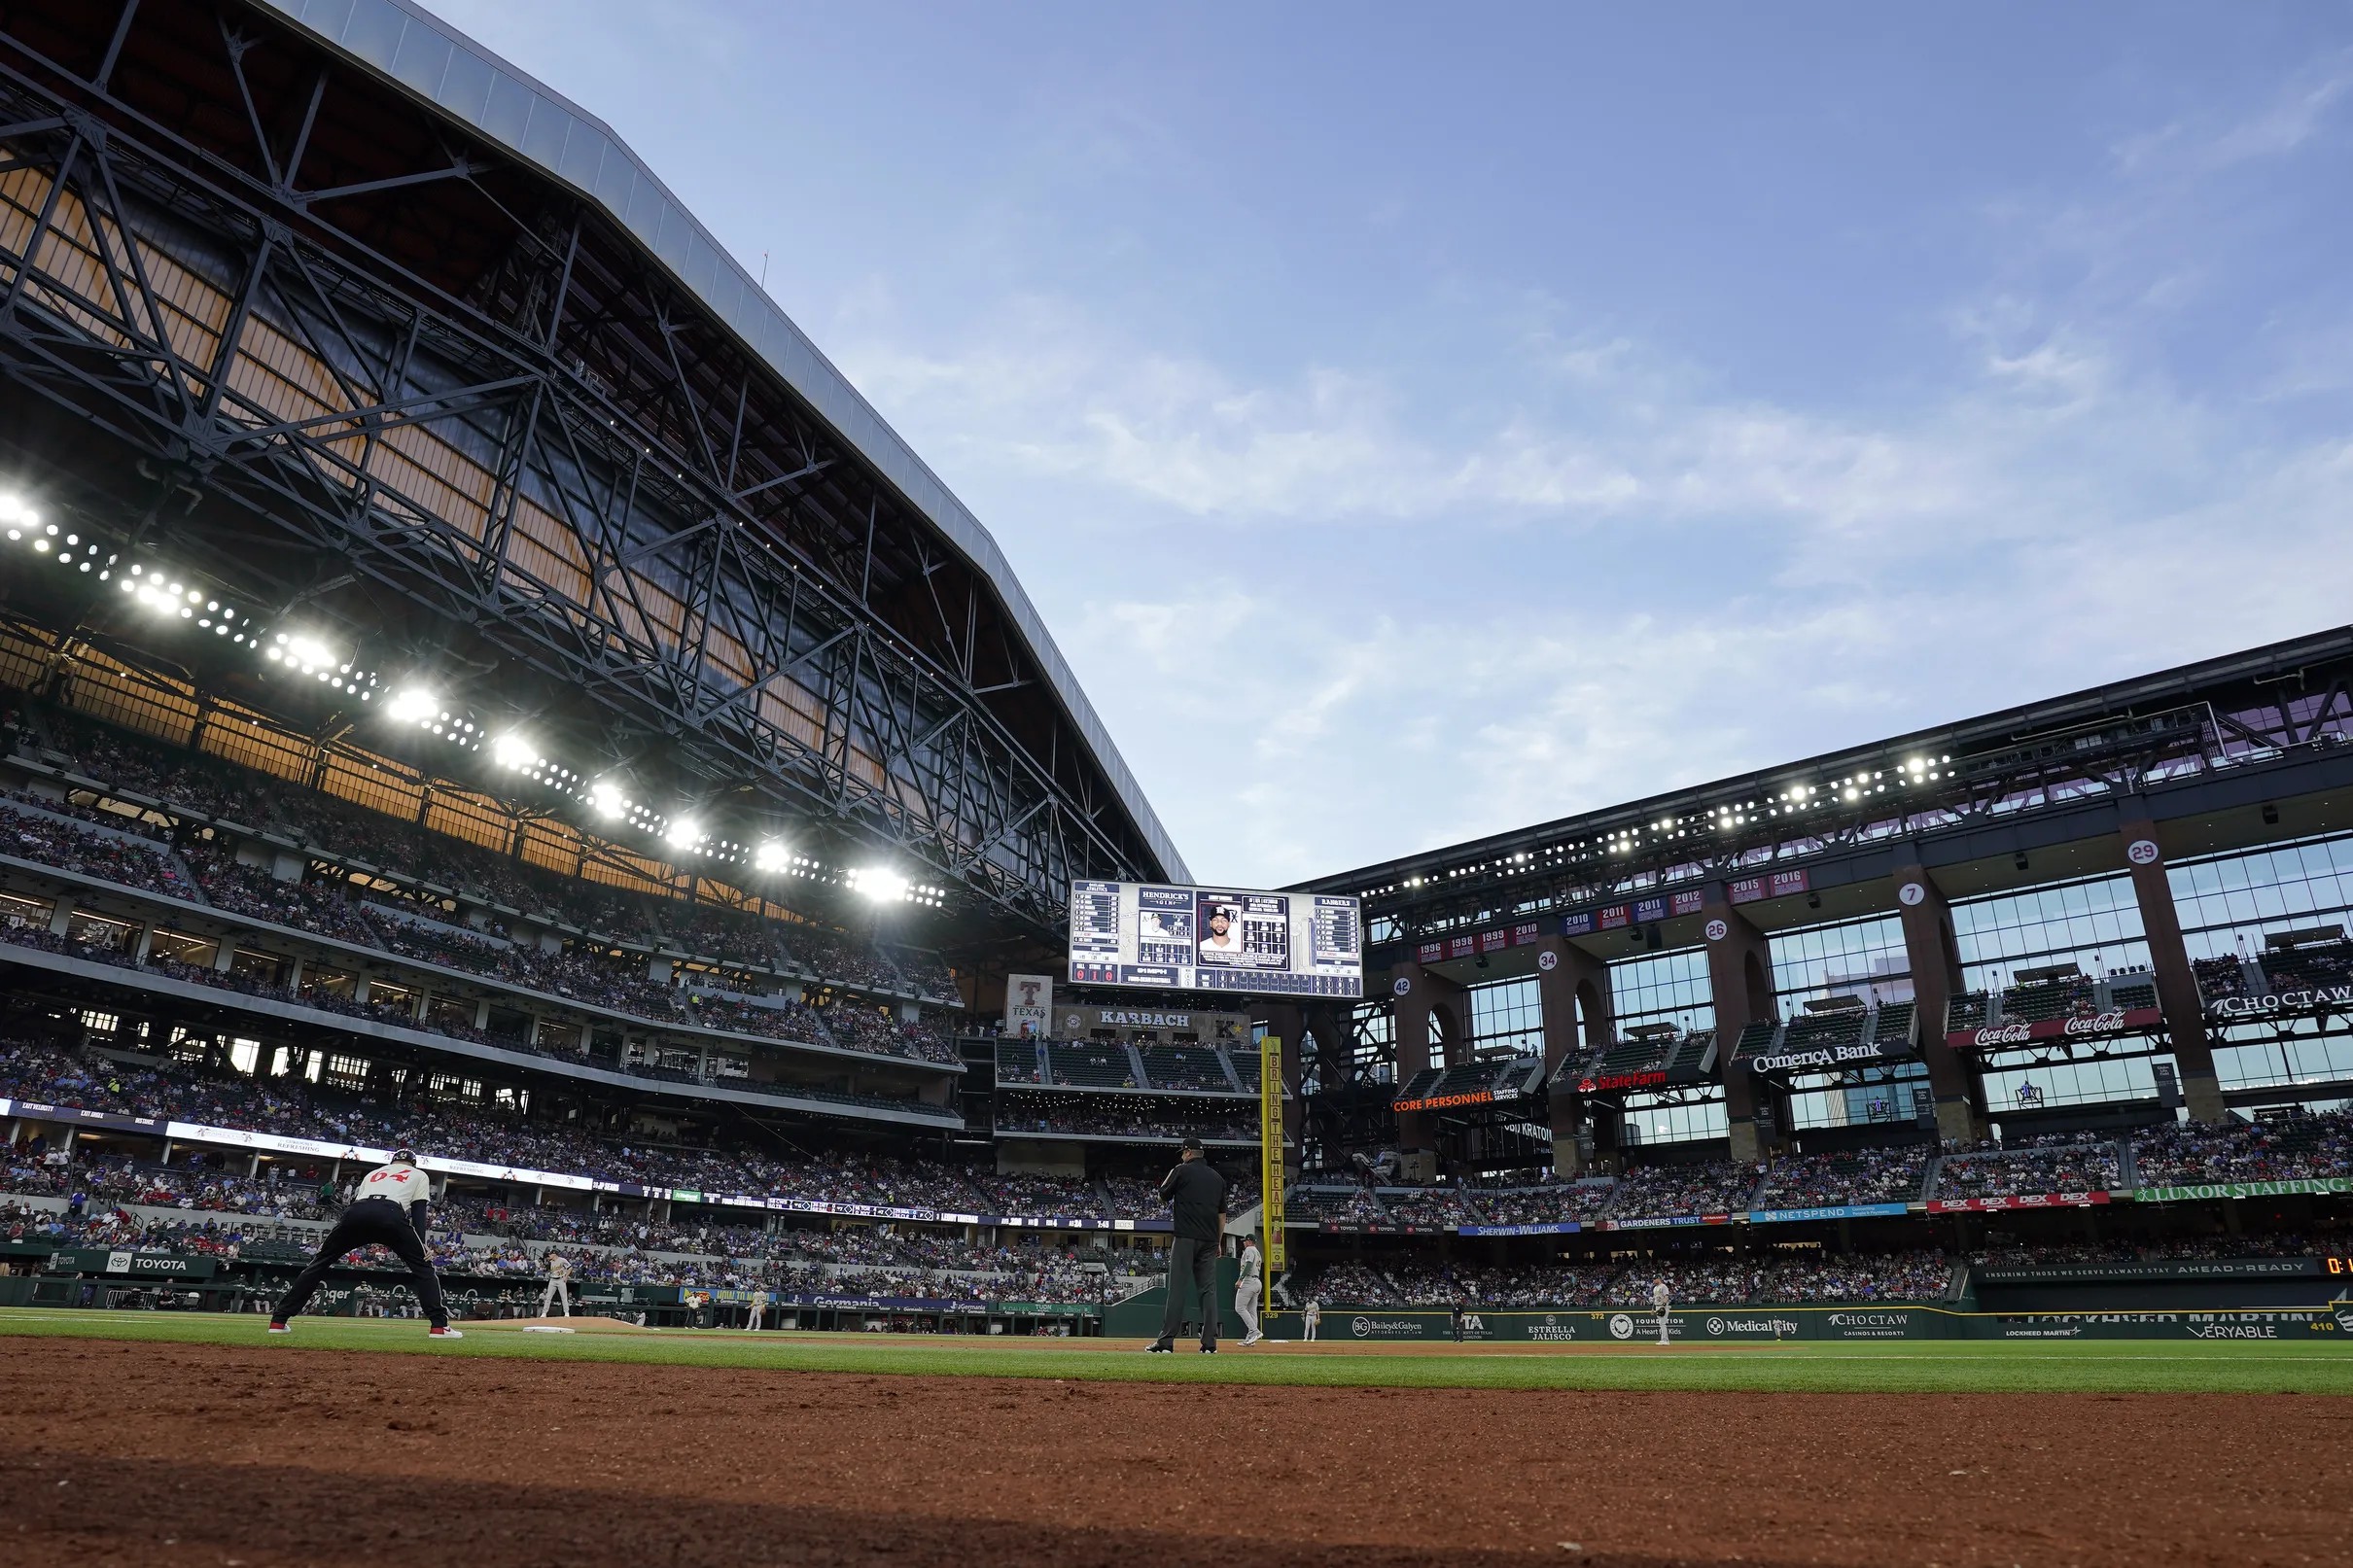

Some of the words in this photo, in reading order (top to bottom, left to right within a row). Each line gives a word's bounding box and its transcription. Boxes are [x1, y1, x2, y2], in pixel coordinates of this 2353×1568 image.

[2132, 845, 2154, 859] 29
[1774, 871, 1801, 885] 2016
[1734, 879, 1759, 892] 2015
[1143, 891, 1189, 900] HENDRICK'S
[1675, 891, 1701, 904] 2012
[1907, 888, 1916, 901] 7
[1638, 899, 1661, 912] 2011
[1603, 906, 1625, 918] 2011
[1566, 913, 1589, 926] 2010
[1516, 923, 1537, 935] 2010
[1708, 924, 1724, 936] 26
[1452, 936, 1473, 948] 1998
[1482, 930, 1505, 942] 1999
[1420, 943, 1441, 954] 1996
[1541, 955, 1556, 967] 34
[1396, 981, 1408, 992] 42
[1020, 981, 1041, 1005] T
[2224, 986, 2351, 1012] CHOCTAW
[1013, 1007, 1046, 1017] TEXAS
[1101, 1011, 1189, 1027] KARBACH
[2064, 1011, 2126, 1035] Coca-Cola
[1974, 1023, 2032, 1046] Coca-Cola
[1835, 1042, 1882, 1061] Bank
[1394, 1099, 1422, 1112] CORE
[1425, 1091, 1493, 1109] PERSONNEL
[277, 1142, 319, 1152] REFRESHING
[370, 1169, 412, 1183] 64
[2154, 1185, 2230, 1201] LUXOR
[2231, 1178, 2346, 1196] STAFFING
[1980, 1197, 2008, 1205] DEX
[2019, 1195, 2048, 1203] DEX
[2060, 1192, 2090, 1201] DEX
[1941, 1199, 1969, 1208] DEX
[1780, 1209, 1845, 1220] NETSPEND
[1620, 1218, 1671, 1229] GARDENERS
[1672, 1216, 1700, 1226] TRUST
[58, 1256, 75, 1265] TOYOTA
[135, 1258, 187, 1270] TOYOTA
[2178, 1265, 2234, 1273] AHEAD
[2246, 1263, 2303, 1272] READY
[814, 1296, 880, 1307] Germania
[1727, 1320, 1772, 1331] Medical
[1836, 1314, 1907, 1325] CHOCTAW
[1371, 1322, 1422, 1331] Bailey&Galyen
